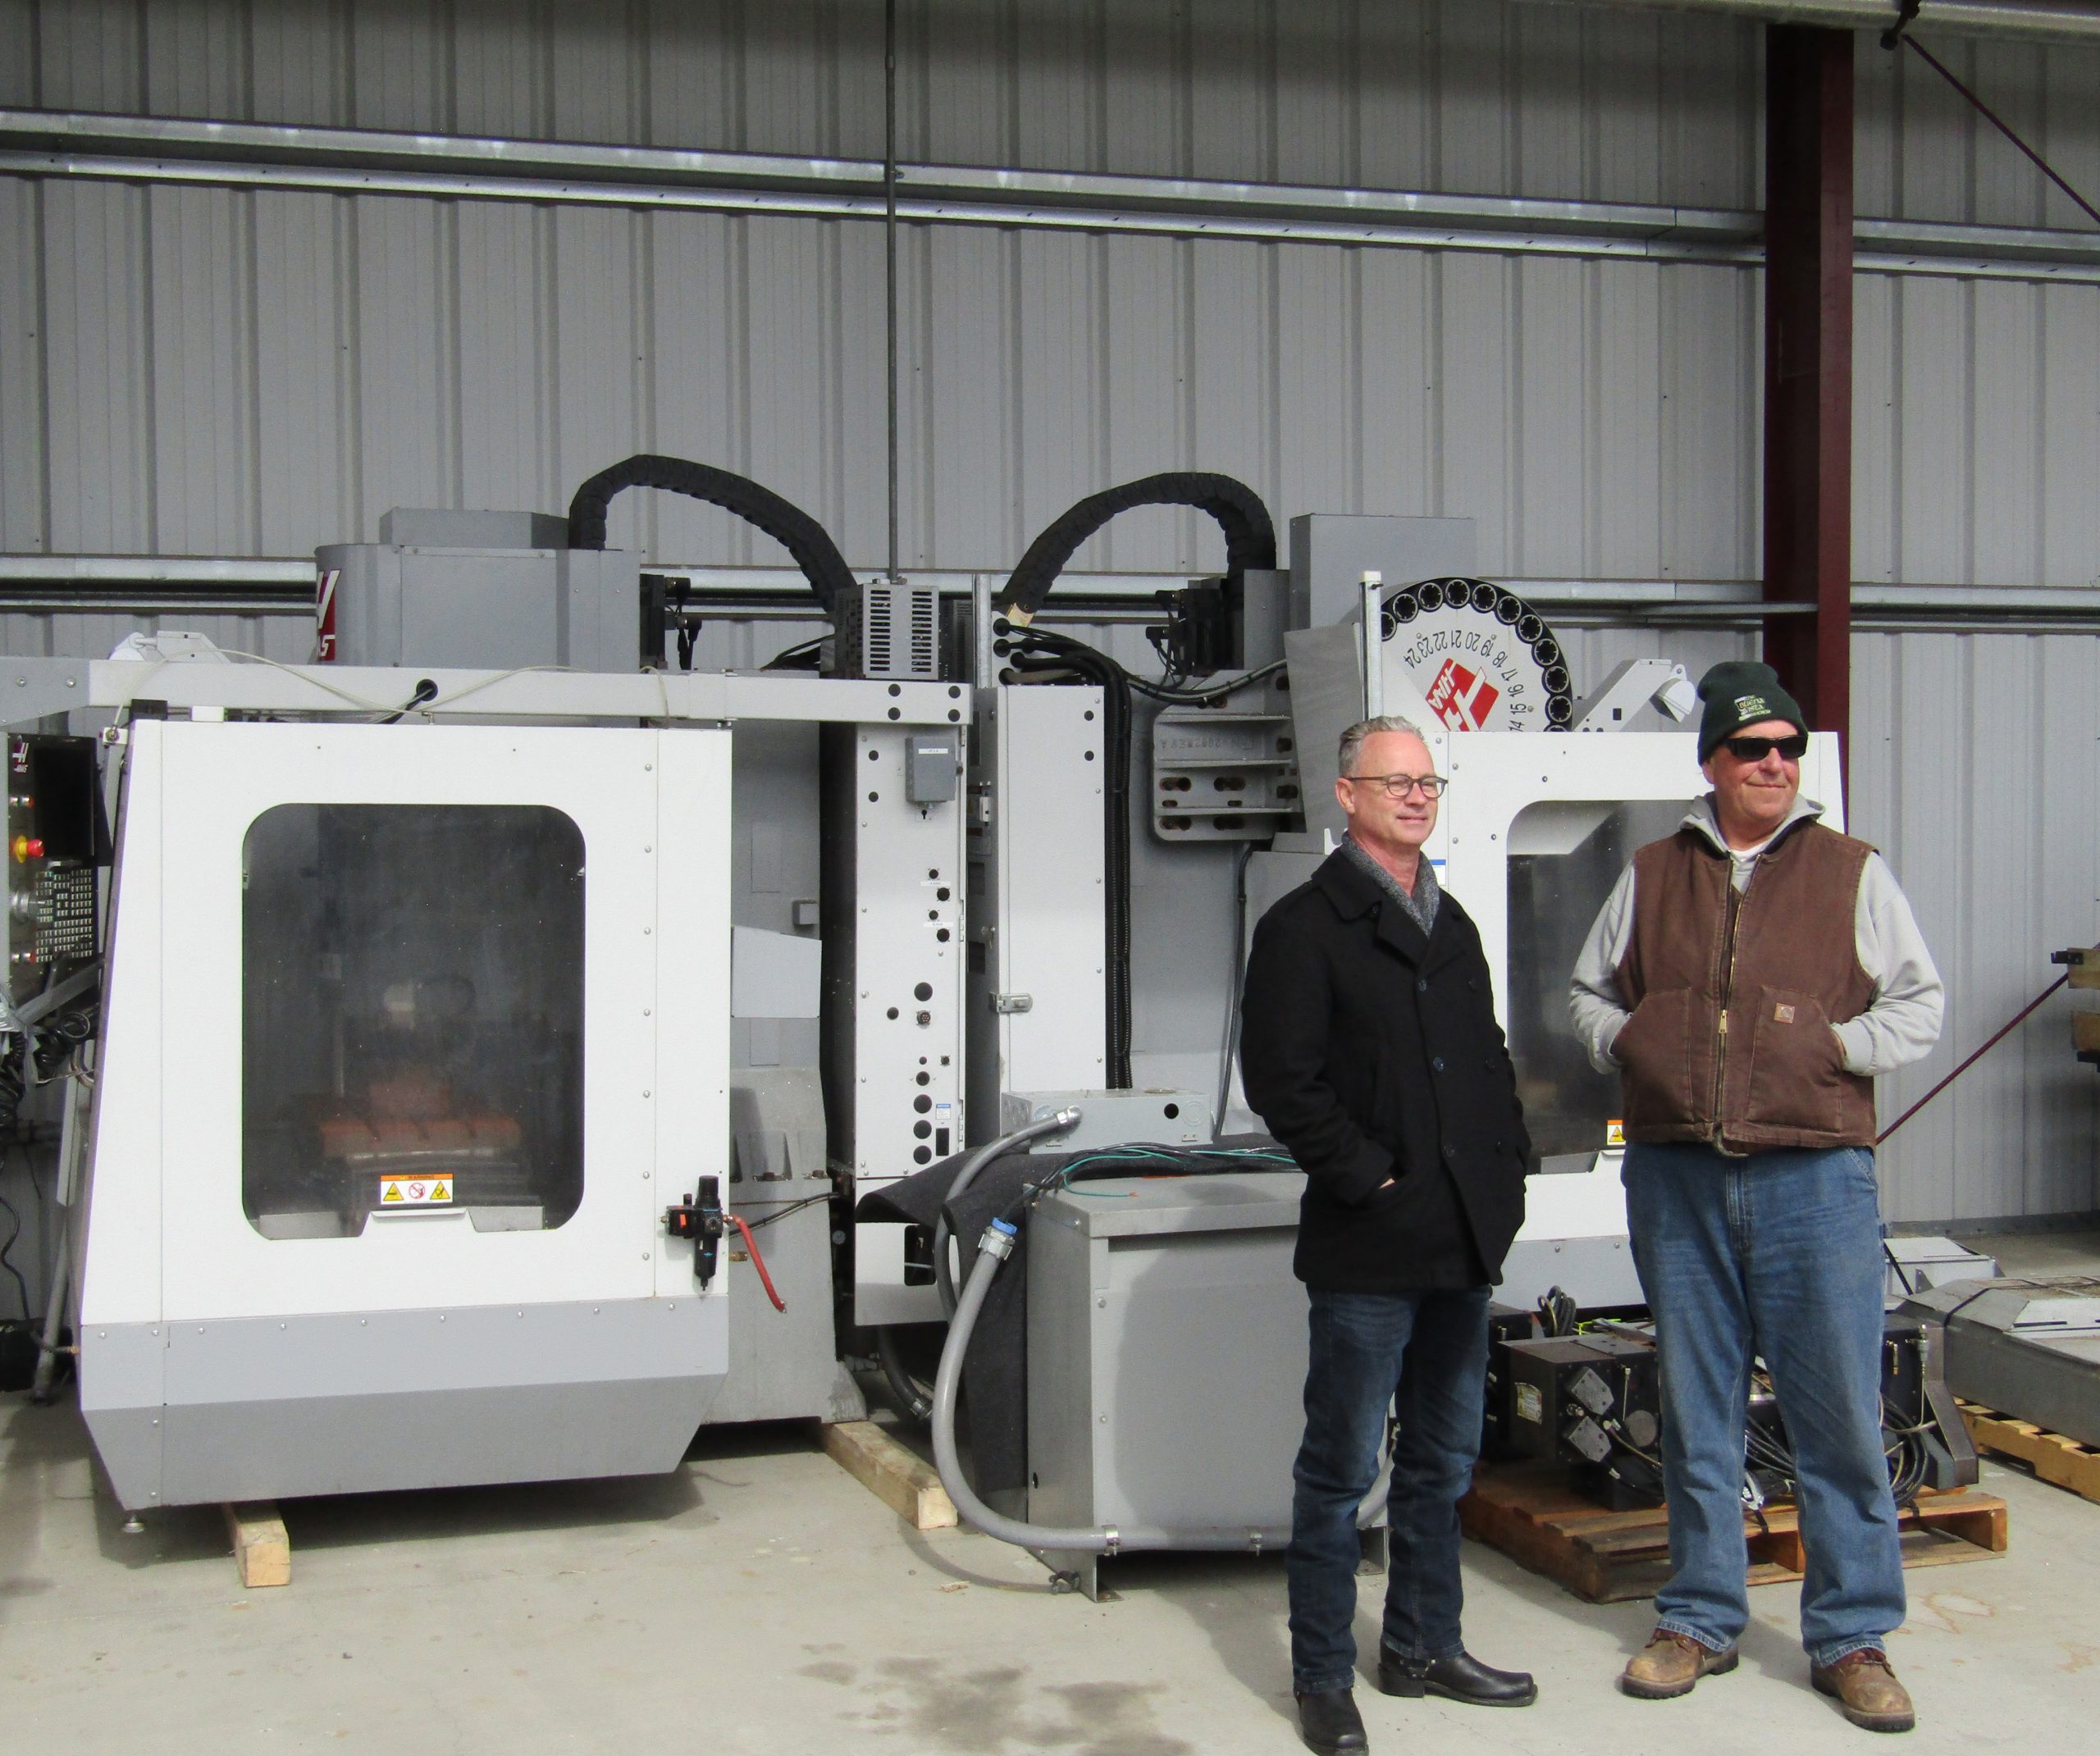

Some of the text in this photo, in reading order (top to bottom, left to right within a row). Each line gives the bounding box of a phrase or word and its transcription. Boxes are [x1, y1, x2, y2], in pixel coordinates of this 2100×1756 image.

[1417, 636, 1434, 658] 23
[1432, 631, 1448, 651] 22
[1450, 630, 1462, 649] 21
[1465, 632, 1481, 651] 20
[1480, 640, 1495, 658] 19
[1404, 648, 1422, 669] 24
[1492, 650, 1509, 668] 18
[1500, 668, 1518, 682] 17
[1507, 684, 1525, 698] 16
[1510, 703, 1527, 715] 15
